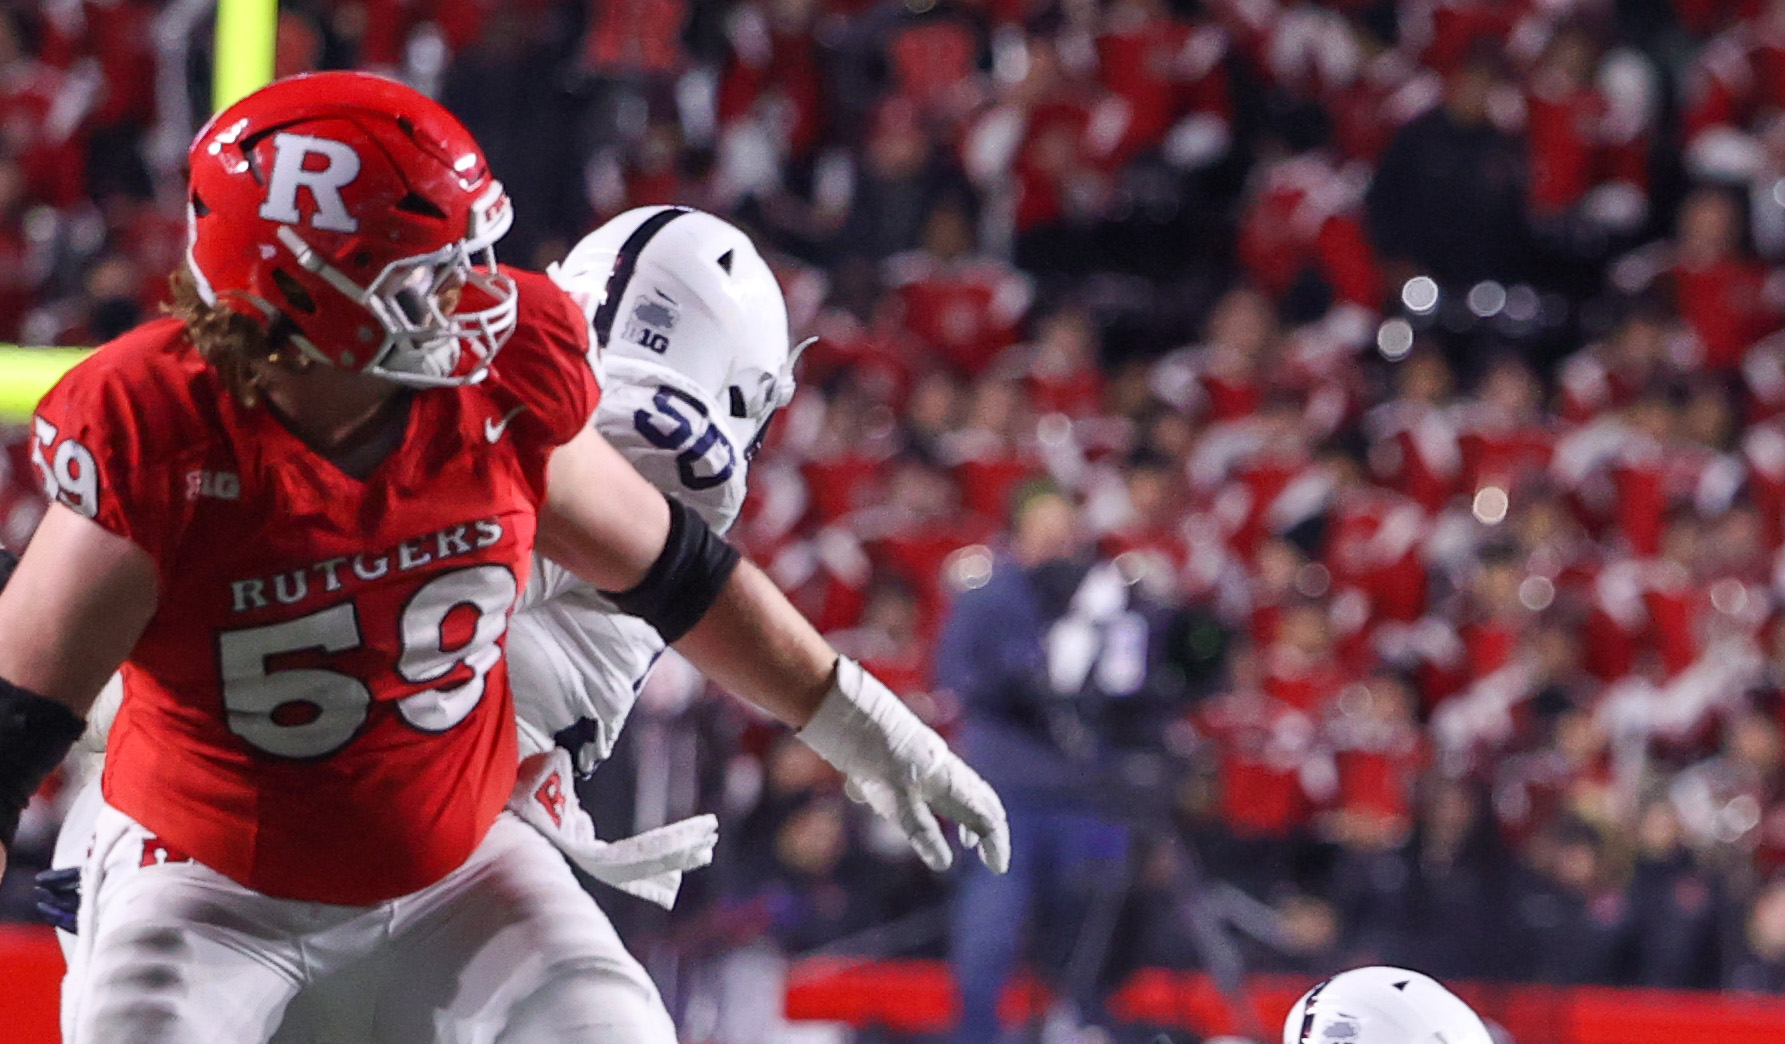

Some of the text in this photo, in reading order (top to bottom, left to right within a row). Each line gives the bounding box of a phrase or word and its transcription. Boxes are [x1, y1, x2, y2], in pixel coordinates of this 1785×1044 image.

[259, 132, 361, 234] R
[34, 415, 99, 519] 59
[231, 515, 503, 612] RUTGERS
[216, 561, 518, 759] 59
